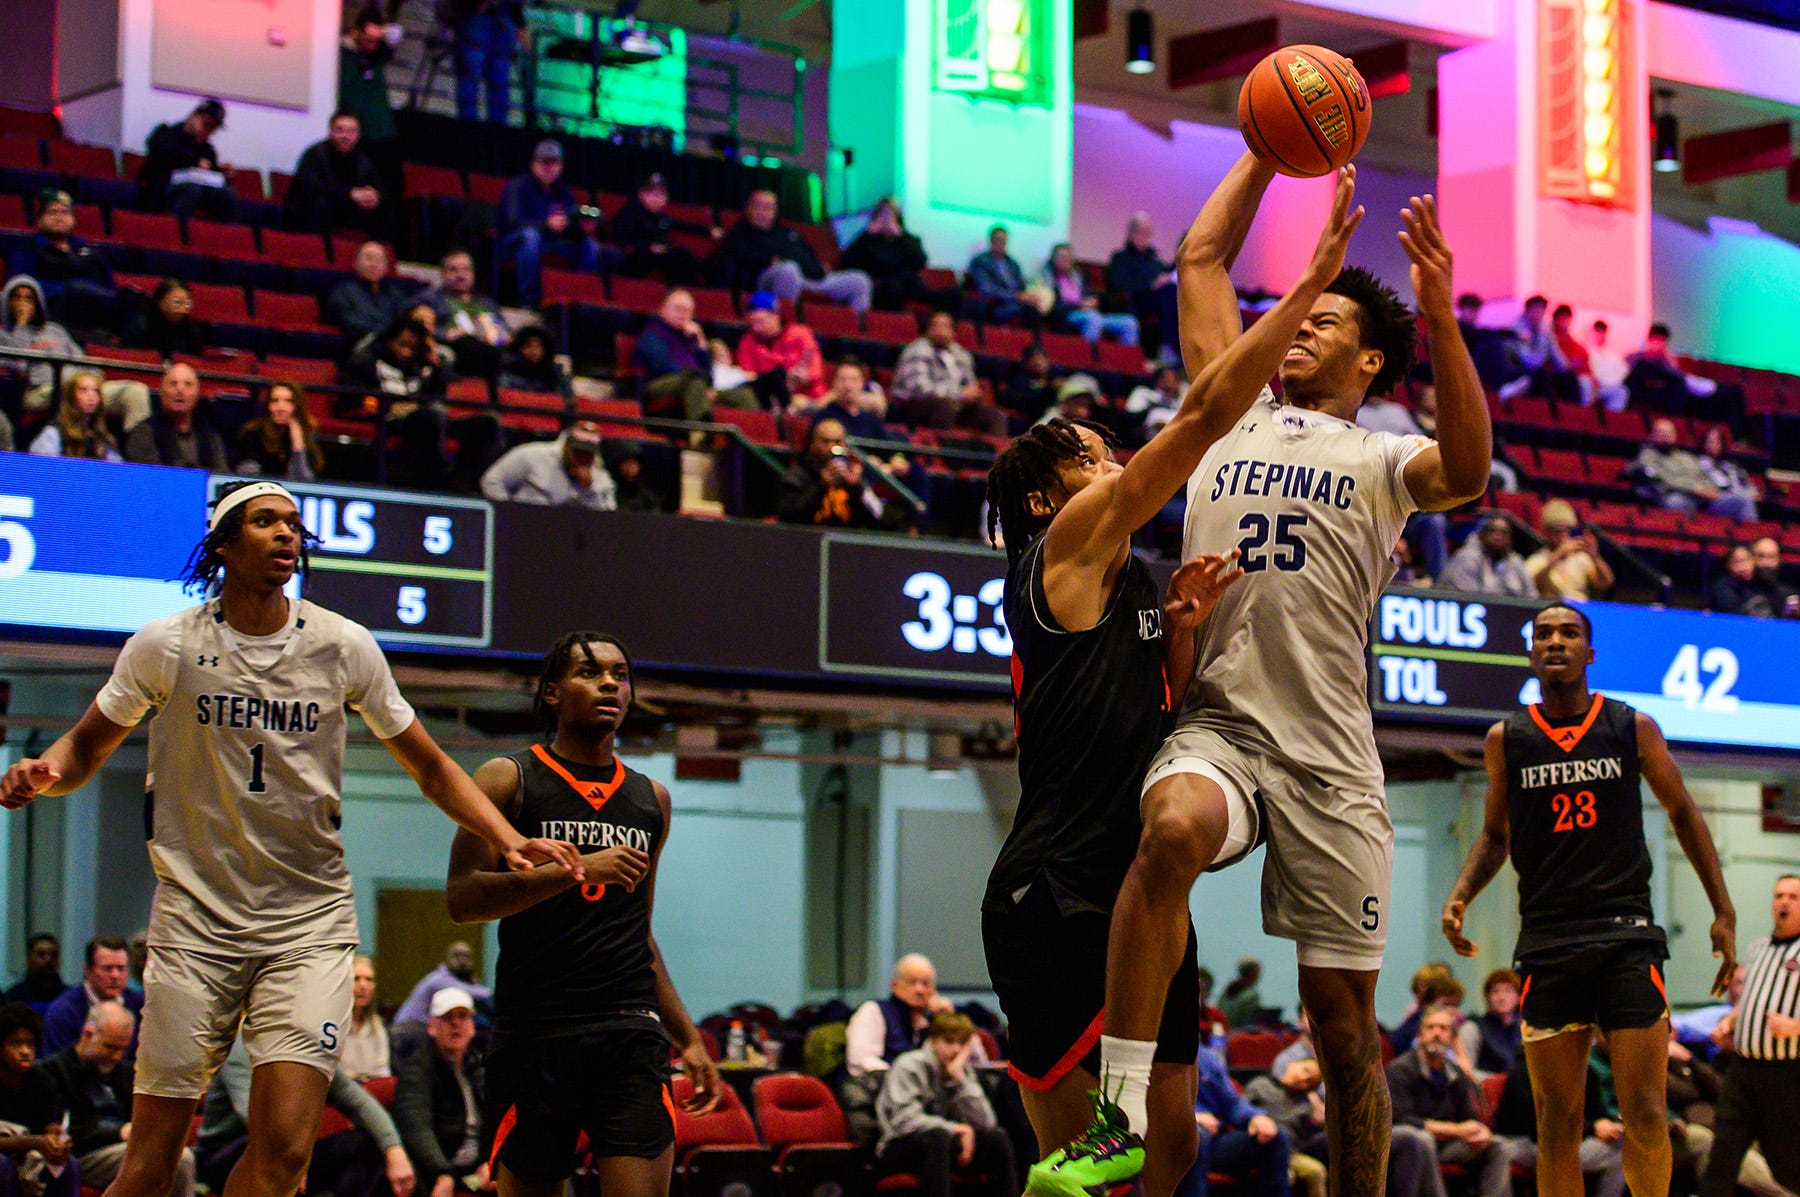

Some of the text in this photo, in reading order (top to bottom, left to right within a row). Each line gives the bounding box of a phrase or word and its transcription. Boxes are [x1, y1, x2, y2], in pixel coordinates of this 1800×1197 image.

[1286, 55, 1349, 150] THE ROCK
[1210, 459, 1357, 511] STEPINAC
[422, 515, 454, 555] 5
[1236, 512, 1309, 573] 25
[396, 585, 428, 626] 5
[901, 571, 1014, 658] 3:3
[1381, 594, 1488, 649] FOULS
[1378, 655, 1448, 706] TOL
[1662, 643, 1740, 714] 42
[196, 694, 319, 733] STEPINAC
[247, 743, 266, 793] 1
[1520, 757, 1622, 790] JEFFERSON
[1551, 790, 1597, 833] 23
[540, 820, 652, 854] JEFFERSON
[1361, 896, 1379, 931] S
[320, 1022, 338, 1050] S
